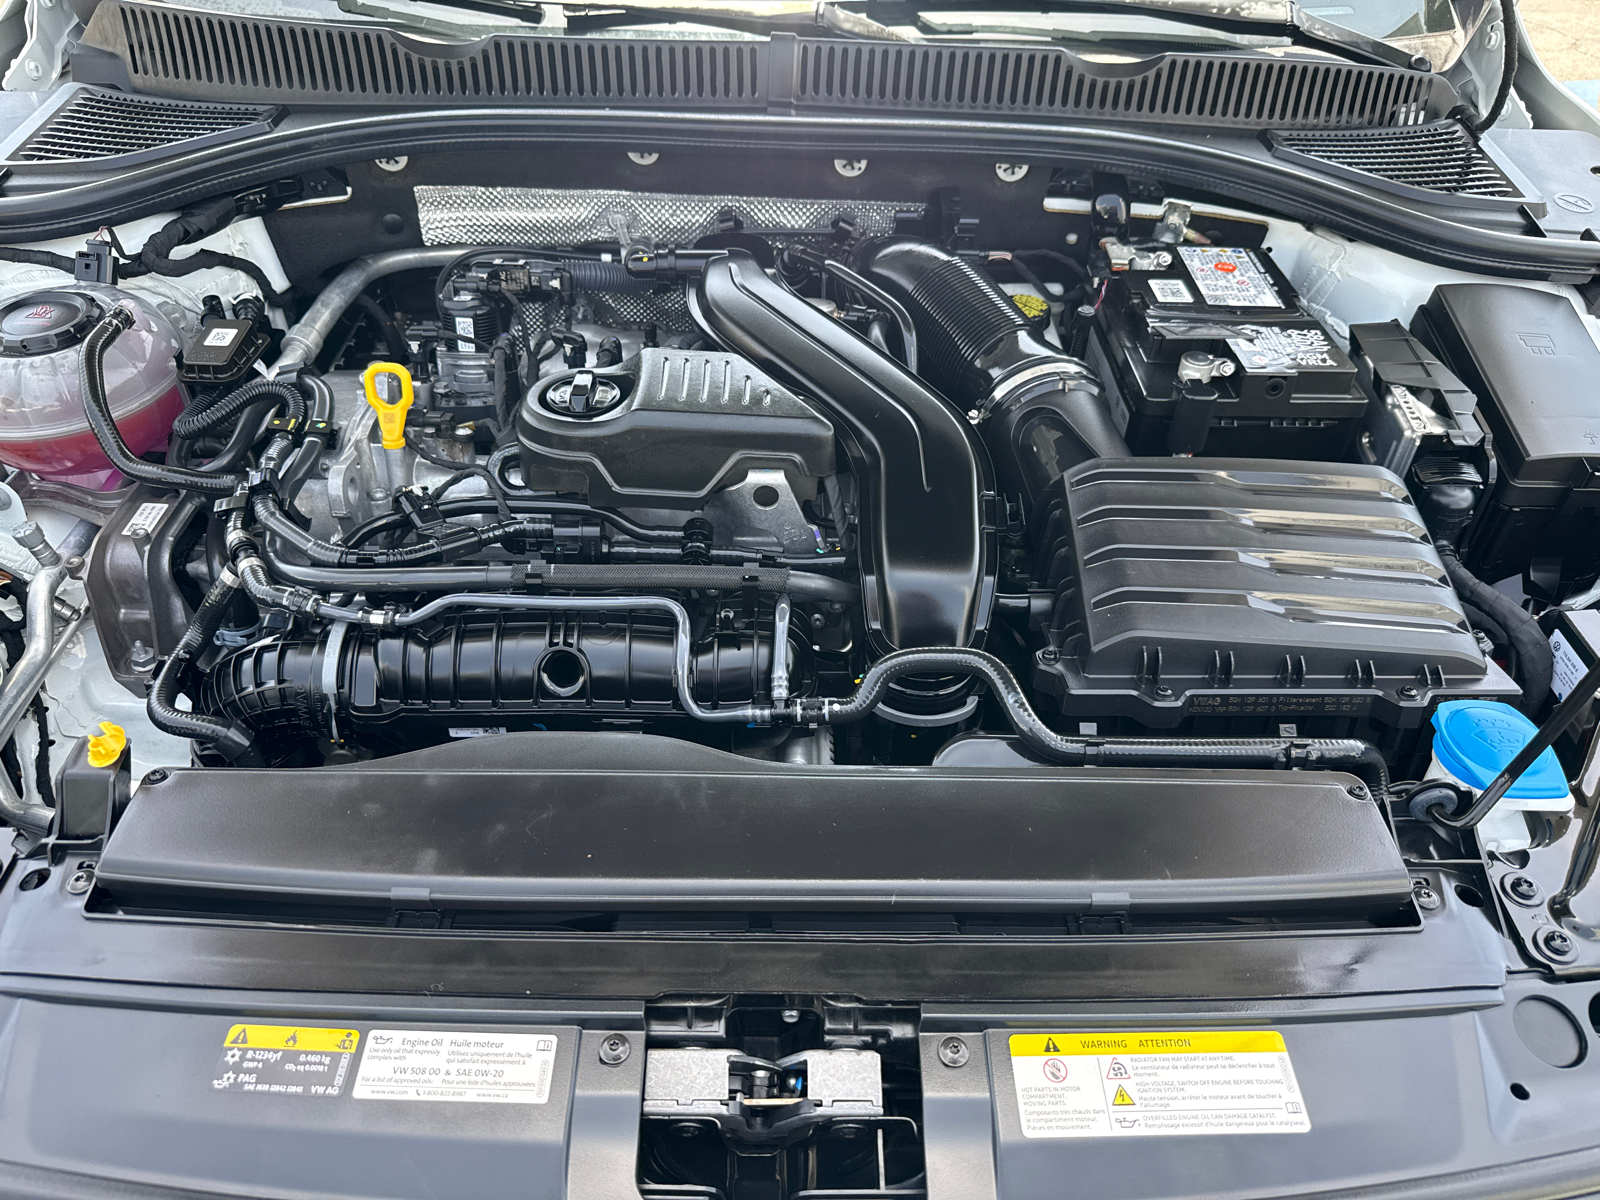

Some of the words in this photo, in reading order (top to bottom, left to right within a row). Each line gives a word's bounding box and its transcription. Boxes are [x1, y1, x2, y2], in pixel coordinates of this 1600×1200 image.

[1194, 697, 1222, 706] VWAG
[402, 1038, 429, 1047] Engine
[1080, 1040, 1128, 1048] WARNING
[1139, 1039, 1191, 1048] ATTENTION
[246, 1050, 283, 1062] R-1234yf
[300, 1054, 320, 1062] 0.460
[321, 1055, 331, 1064] kg
[238, 1074, 257, 1083] PAG
[311, 1085, 327, 1094] VW
[327, 1086, 339, 1095] AG
